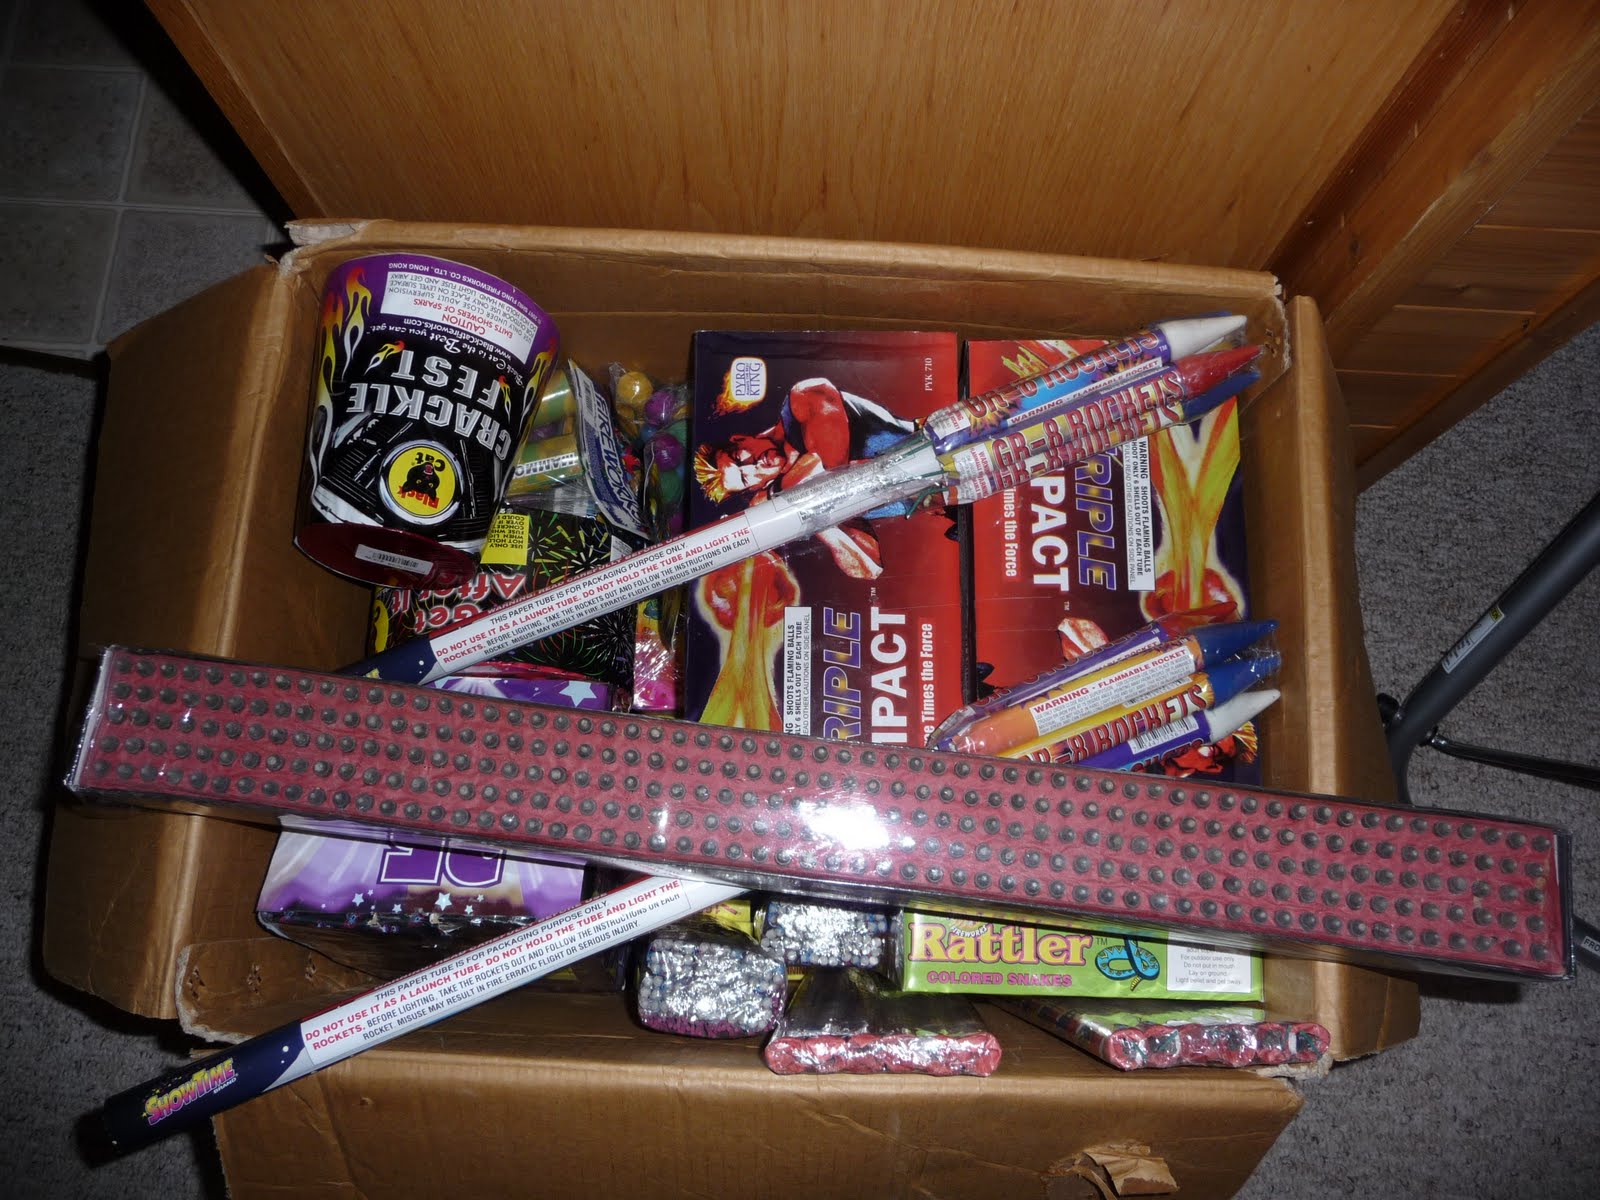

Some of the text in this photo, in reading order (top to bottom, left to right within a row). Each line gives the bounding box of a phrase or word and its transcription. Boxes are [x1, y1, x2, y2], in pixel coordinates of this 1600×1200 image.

[408, 263, 429, 271] HONG
[448, 271, 460, 279] CO.
[388, 287, 434, 298] SUPERVISION
[436, 294, 459, 304] ADULT
[462, 275, 500, 295] FIREWORKS
[501, 291, 517, 305] FUNG
[413, 298, 512, 338] EMITS SHOWERS OF SPARKS
[441, 313, 485, 335] CAUTION
[462, 301, 484, 314] CLOSE
[485, 311, 507, 324] UNDER
[403, 318, 511, 360] www.BlackCatFireworks.com
[408, 328, 426, 336] you
[429, 332, 460, 353] Best
[461, 342, 475, 352] the
[488, 353, 506, 370] Cat
[390, 349, 500, 409] FEST
[735, 362, 745, 395] PYRO
[749, 362, 760, 395] KING
[924, 374, 932, 390] PYK
[1010, 359, 1159, 424] WARNING FLAMMABLE ROCKET
[1064, 368, 1186, 440] ROCKETS
[345, 382, 511, 460] CRACKLE
[1074, 449, 1117, 590] RIPLE
[1138, 440, 1151, 572] WARNING SHOOTS FLAMING BALLS
[1003, 487, 1019, 577] imes the Force
[1030, 474, 1070, 591] PACT
[435, 527, 749, 657] DO NOT USE IT AS A LAUNCH TUBE. DO NOT HOLD THE TUBE AND LIGHT THE
[489, 541, 687, 625] THIS PAPER TUBE IS FOR PACKAGING PURPOSE ONLY.
[786, 624, 794, 647] BALLS
[786, 650, 795, 682] FLAMING
[795, 661, 801, 669] OF
[823, 607, 861, 740] RIPLE
[871, 606, 907, 743] PACT
[920, 623, 935, 722] Times the Force
[1033, 686, 1089, 714] WARNING
[1097, 662, 1150, 688] FLAMMABLE
[1151, 648, 1186, 667] ROCKET
[786, 684, 794, 715] SHOOTS
[1090, 683, 1207, 752] ROCKETS
[304, 879, 679, 1041] DO NOT USE IT AS A LAUNCH TUBE. DO NOT HOLD THE TUBE AND LIGHT THE
[374, 987, 396, 1001] THIS
[396, 974, 428, 992] PAPER
[429, 963, 454, 978] TUBE
[454, 959, 464, 968] IS
[465, 950, 487, 964] FOR
[486, 928, 539, 955] PACKAGING
[539, 909, 583, 933] PURPOSE
[907, 921, 1093, 967] Rattler
[396, 1008, 427, 1026] MISUSE
[427, 1000, 445, 1013] MAY
[445, 988, 475, 1005] RESULT
[476, 983, 486, 993] IN
[537, 950, 565, 967] FLIGHT
[565, 945, 577, 956] OR
[577, 931, 611, 950] SERIOUS
[926, 971, 1073, 988] COLORED SNAKES
[213, 1077, 236, 1094] BRAND
